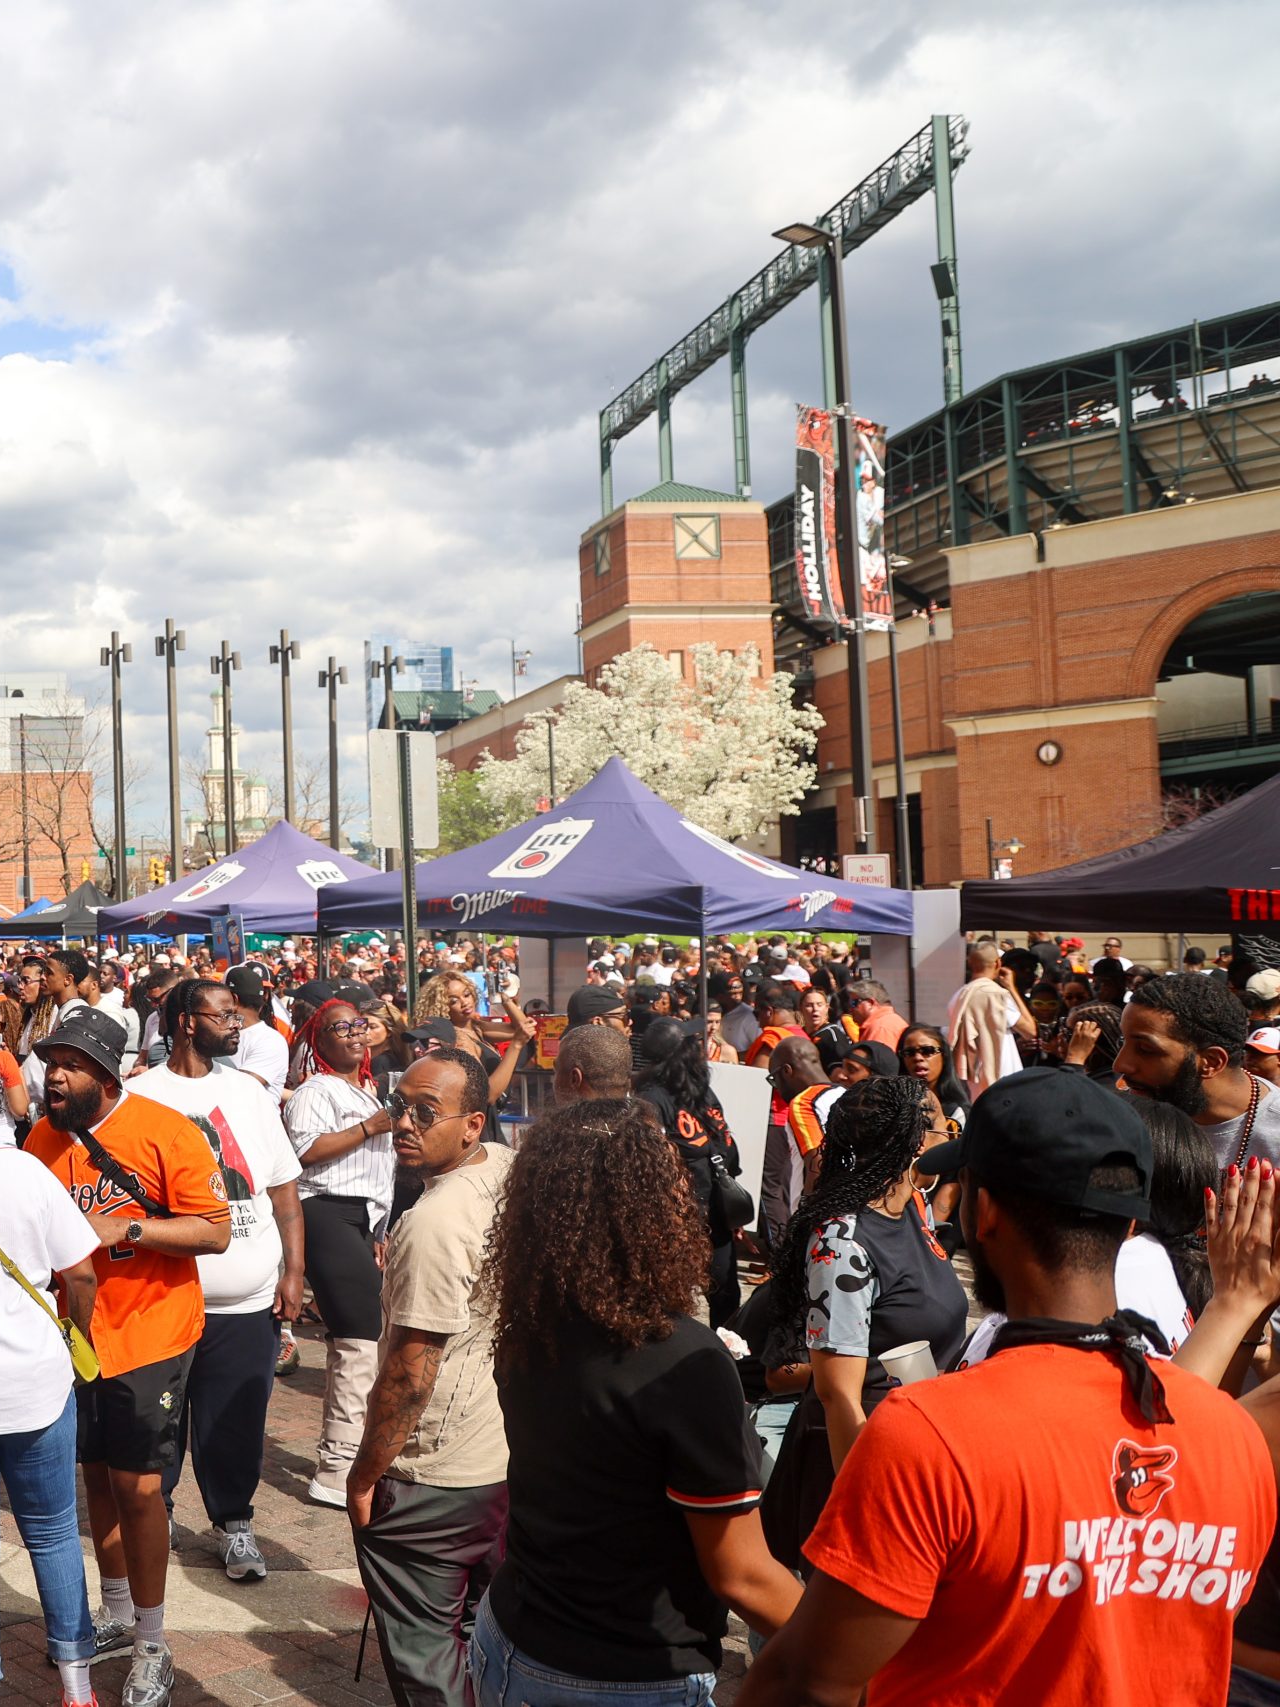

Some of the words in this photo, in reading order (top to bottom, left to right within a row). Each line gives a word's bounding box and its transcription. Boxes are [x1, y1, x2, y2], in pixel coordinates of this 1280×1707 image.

[800, 484, 823, 601] HOLLIDAY
[526, 832, 579, 851] Lite
[306, 870, 341, 883] Lite
[850, 876, 885, 885] PARKING
[860, 865, 874, 873] NO
[451, 889, 527, 924] Miller
[511, 896, 550, 915] TIME
[1063, 1516, 1238, 1568] WELCOME
[1022, 1561, 1083, 1600] TO
[1129, 1558, 1252, 1611] SHOW
